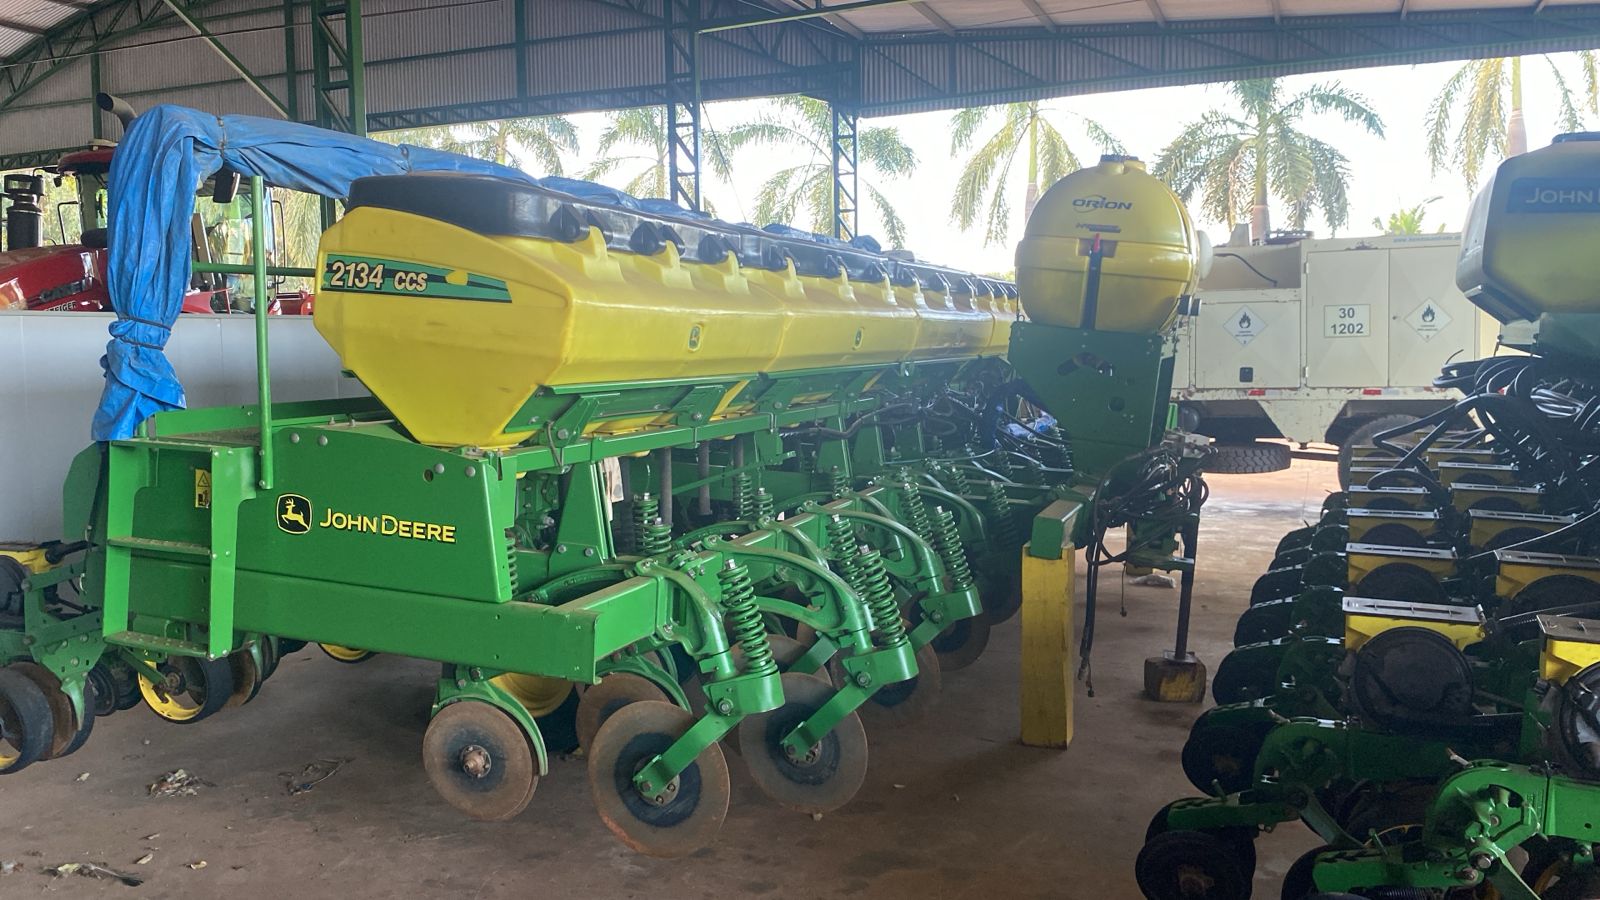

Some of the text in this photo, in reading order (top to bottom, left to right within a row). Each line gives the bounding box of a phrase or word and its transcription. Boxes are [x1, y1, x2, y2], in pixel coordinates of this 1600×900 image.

[1072, 196, 1133, 210] ORION
[1525, 187, 1593, 204] JOHN
[330, 261, 428, 292] 2134 CCS
[1338, 307, 1355, 319] 30
[1330, 323, 1364, 334] 1202
[319, 508, 457, 543] JOHN DEERE
